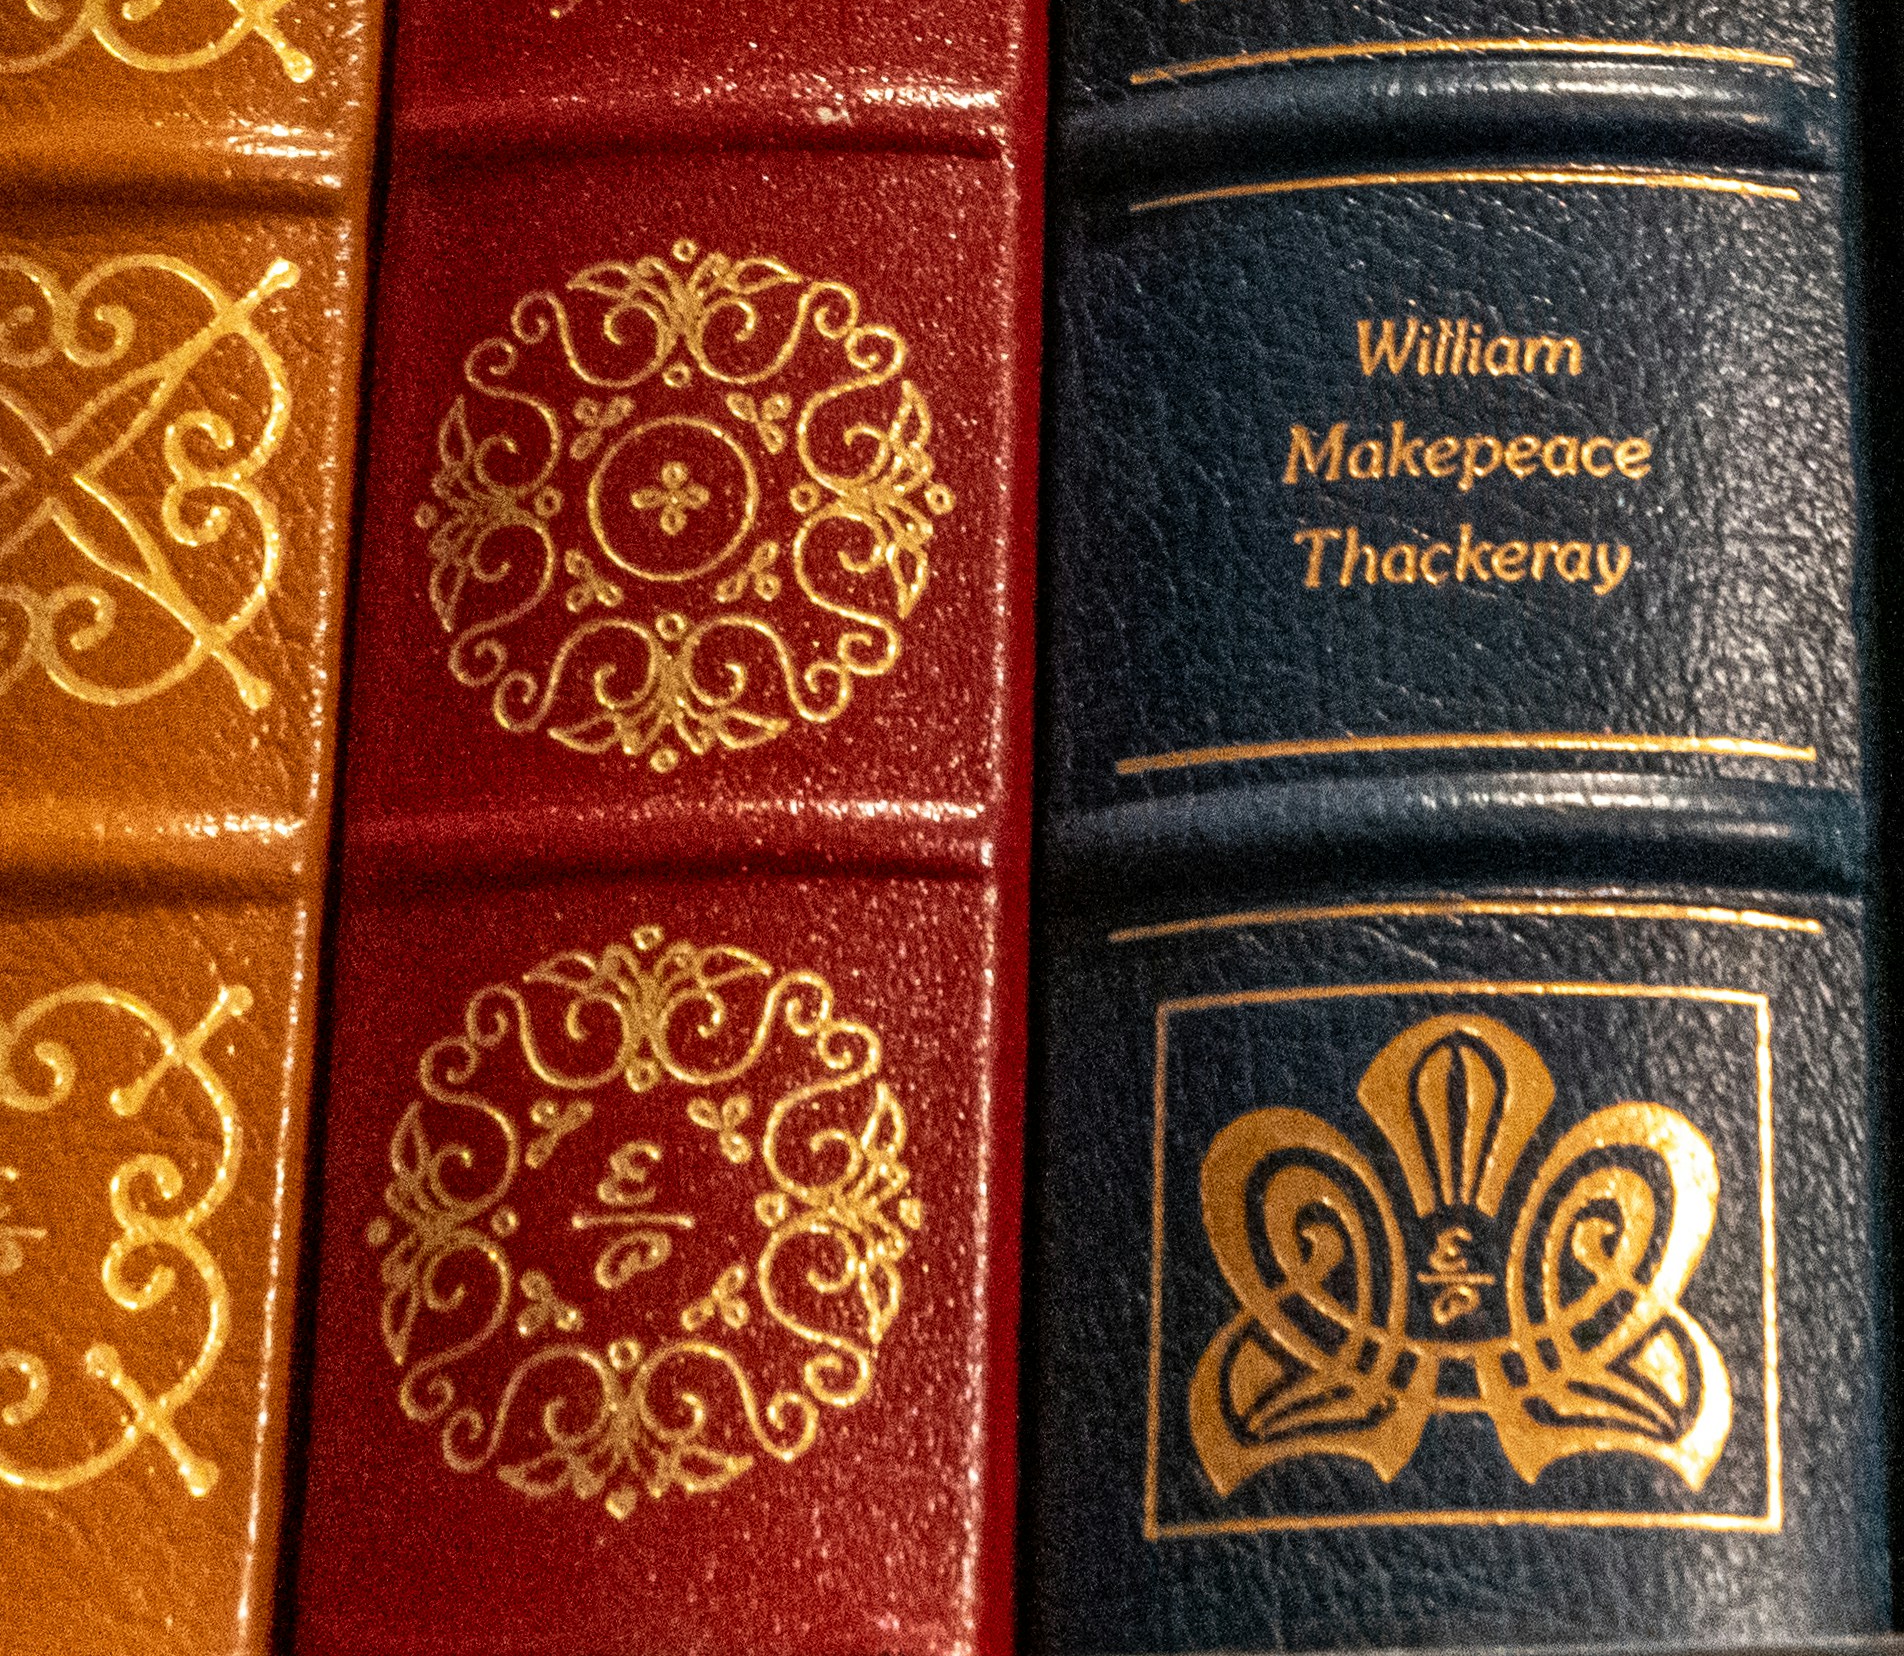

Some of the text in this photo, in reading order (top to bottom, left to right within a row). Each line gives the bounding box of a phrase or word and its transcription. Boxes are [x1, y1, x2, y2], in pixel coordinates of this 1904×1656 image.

[1356, 317, 1585, 377] William
[1282, 420, 1653, 493] Makepeace
[1293, 523, 1634, 596] Thackeray
